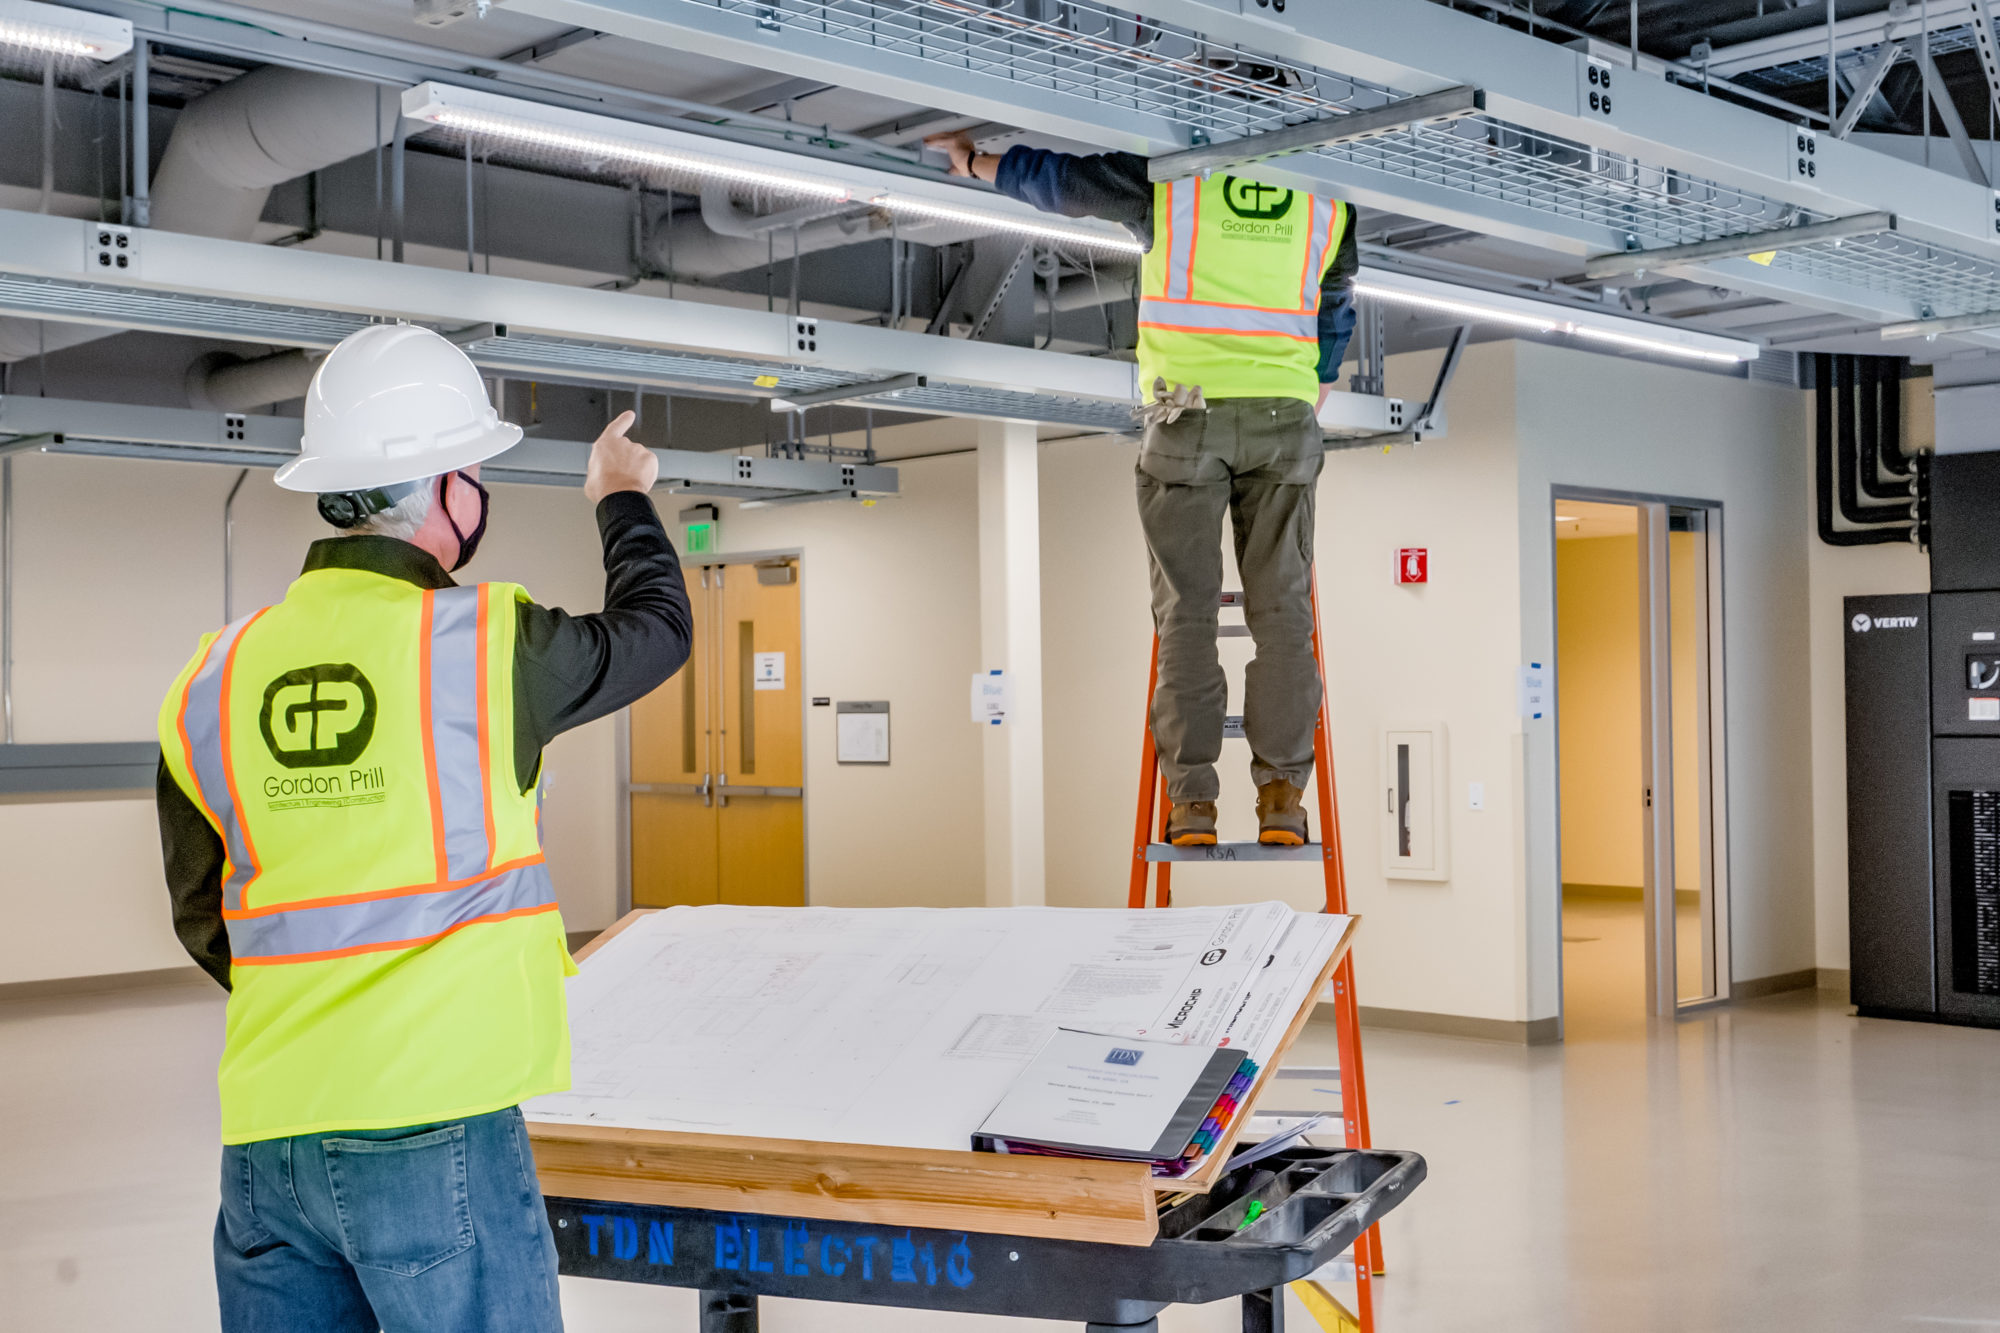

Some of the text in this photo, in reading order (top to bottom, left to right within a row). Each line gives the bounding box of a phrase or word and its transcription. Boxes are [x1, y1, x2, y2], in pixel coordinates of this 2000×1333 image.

[1221, 219, 1293, 236] Gordon Prill
[1873, 617, 1918, 628] VERTIV
[267, 678, 368, 755] GP
[264, 767, 385, 797] Gordon Prill
[1206, 847, 1236, 861] RSA
[1111, 1049, 1138, 1061] TDN
[582, 1214, 674, 1266] TDN
